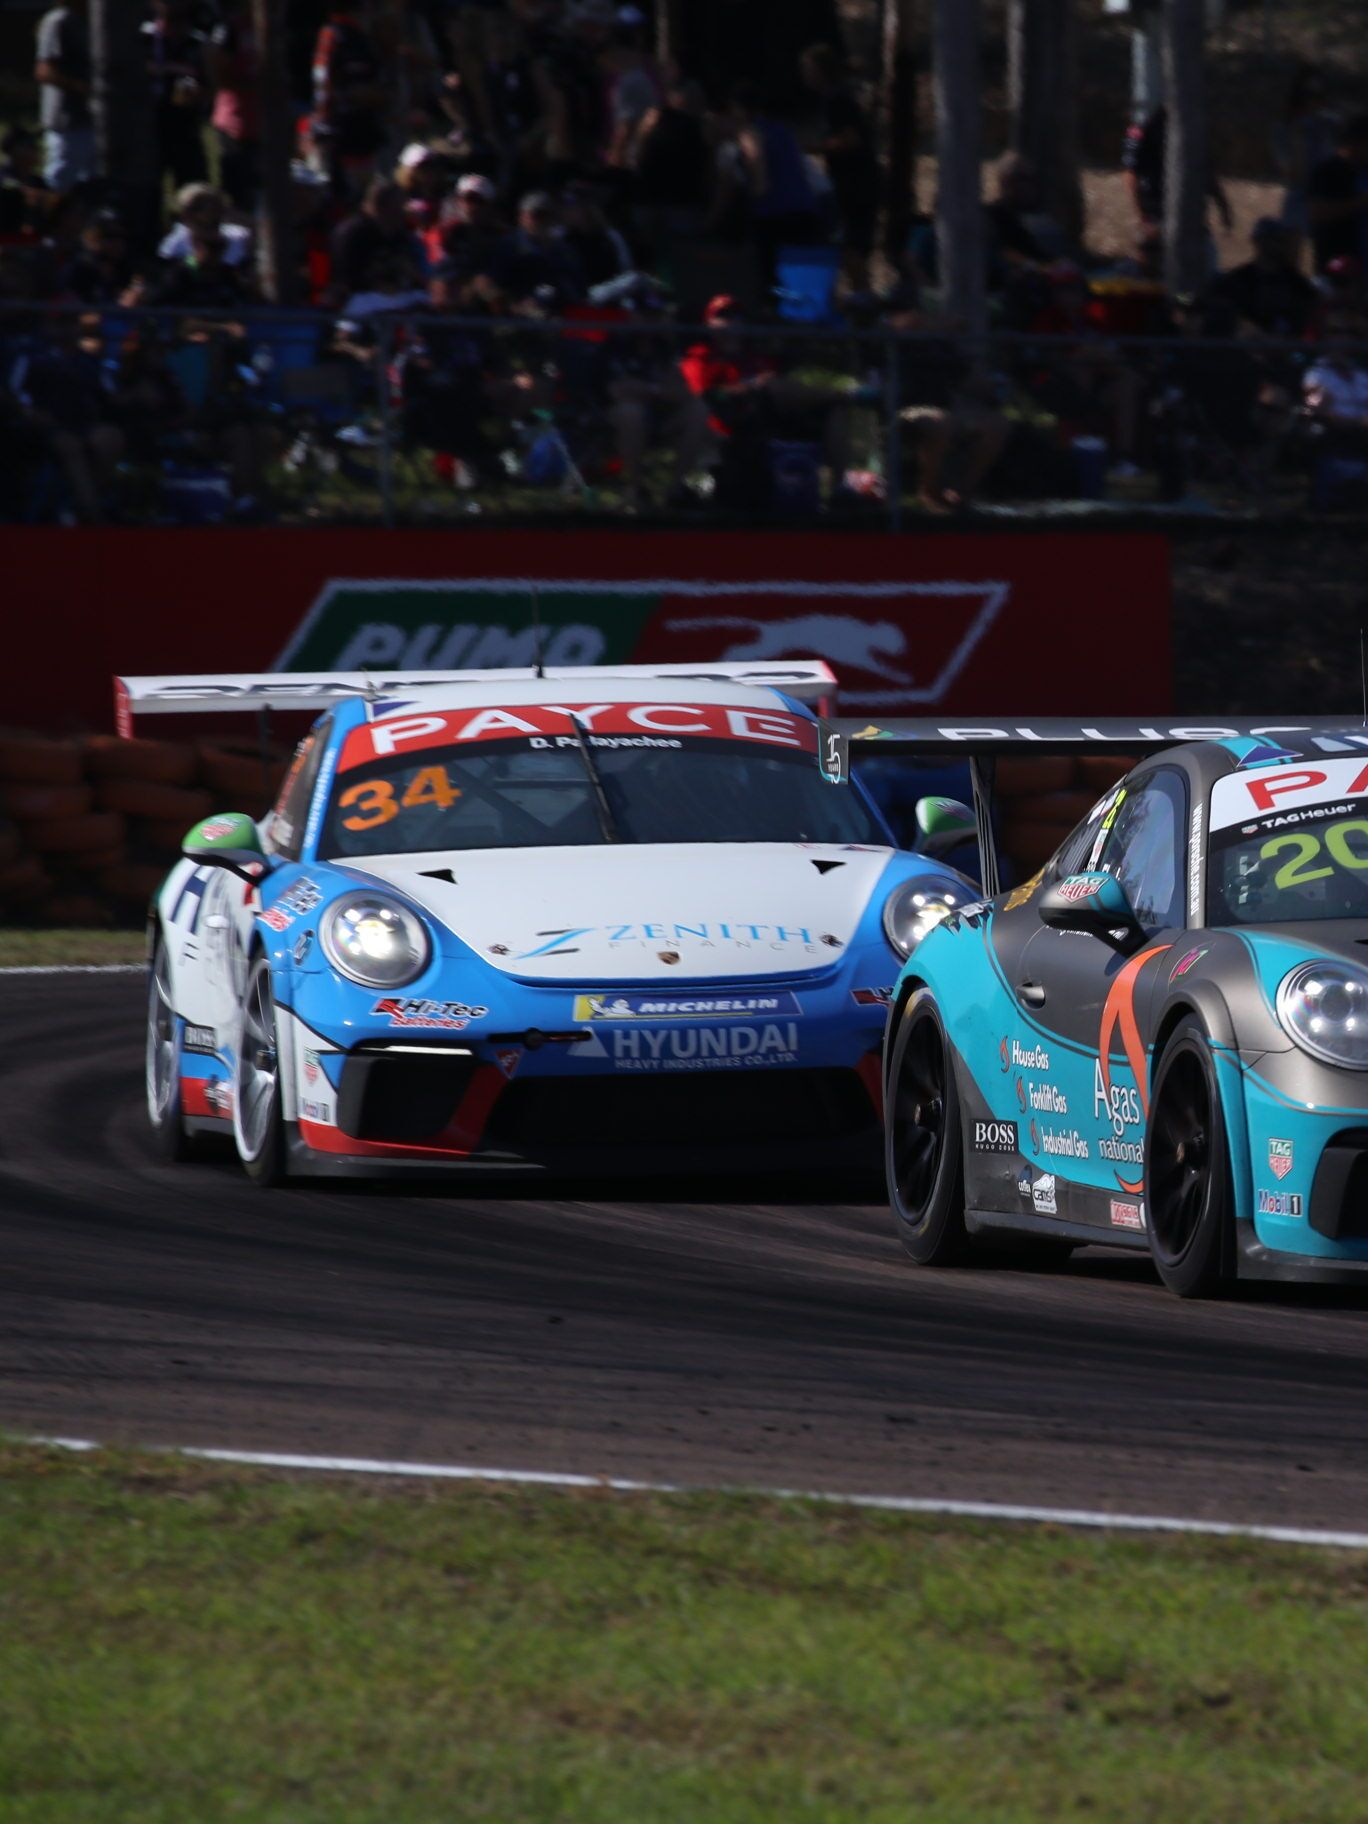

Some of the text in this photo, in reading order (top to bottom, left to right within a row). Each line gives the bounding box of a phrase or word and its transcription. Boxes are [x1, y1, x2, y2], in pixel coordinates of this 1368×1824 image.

[369, 703, 801, 756] PAYCE
[337, 765, 463, 832] 34
[605, 923, 812, 943] ZENITH
[638, 999, 780, 1013] MICHELIN
[613, 1022, 799, 1059] HYUNDAI
[614, 1057, 661, 1070] HEAVY
[662, 1056, 742, 1069] INDUSTRIES
[1012, 1040, 1049, 1070] House Gas
[1053, 1086, 1067, 1114] Gas
[1094, 1057, 1140, 1136] Agas
[975, 1122, 1015, 1145] BOSS
[1074, 1132, 1089, 1159] Gas
[1270, 1141, 1292, 1156] TAG
[1258, 1188, 1289, 1215] Mobil
